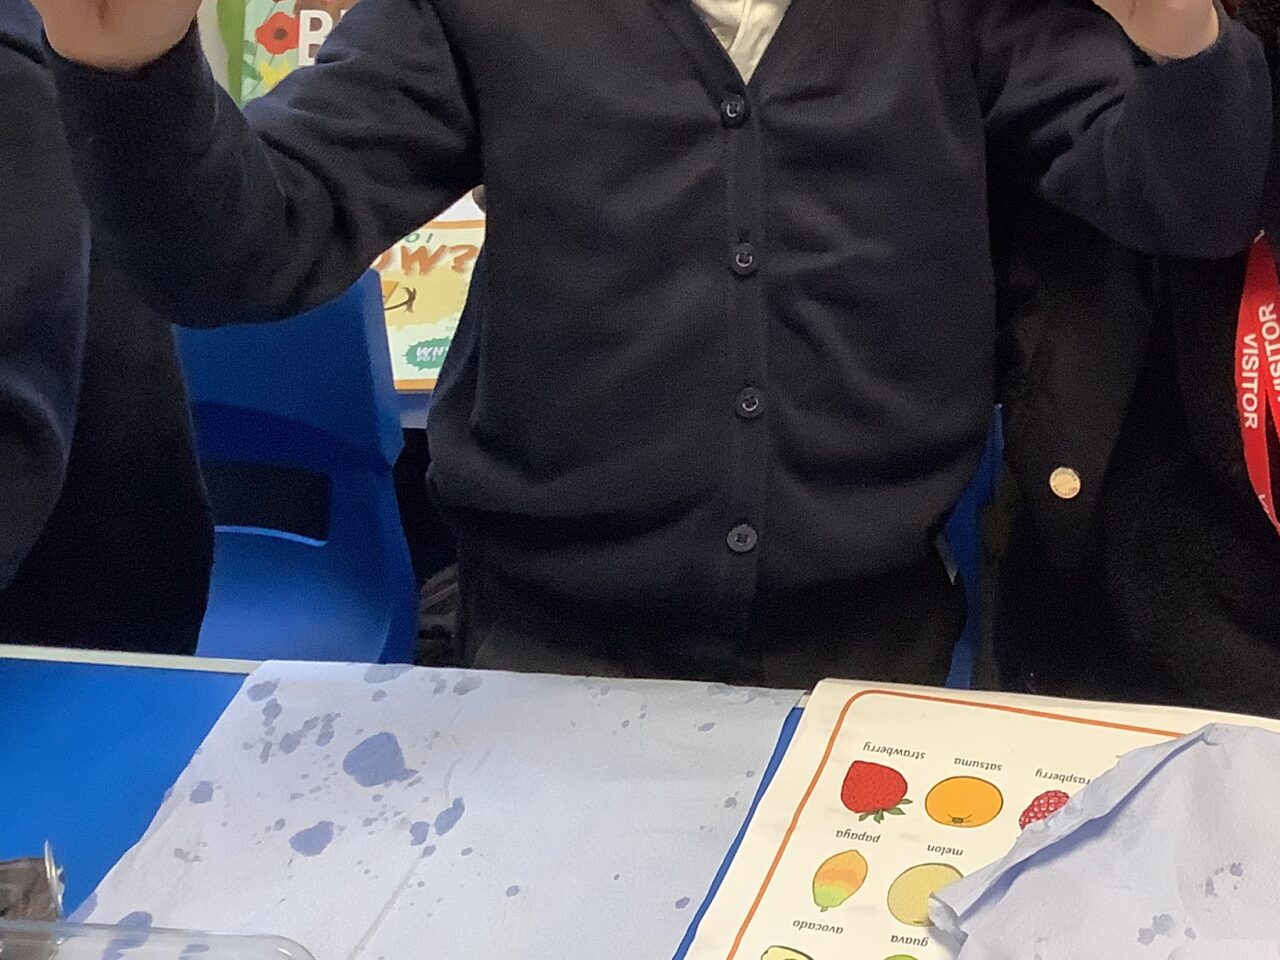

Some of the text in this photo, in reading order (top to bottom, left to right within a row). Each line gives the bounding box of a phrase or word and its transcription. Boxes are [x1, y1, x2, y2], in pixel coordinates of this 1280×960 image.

[1241, 333, 1258, 430] VISITOR
[863, 741, 926, 760] strawberry
[953, 757, 1003, 772] satsuma
[1034, 767, 1091, 785] raspberry
[835, 828, 881, 843] papaya
[927, 844, 964, 856] melon
[792, 919, 844, 935] avocado
[890, 934, 929, 948] guava
